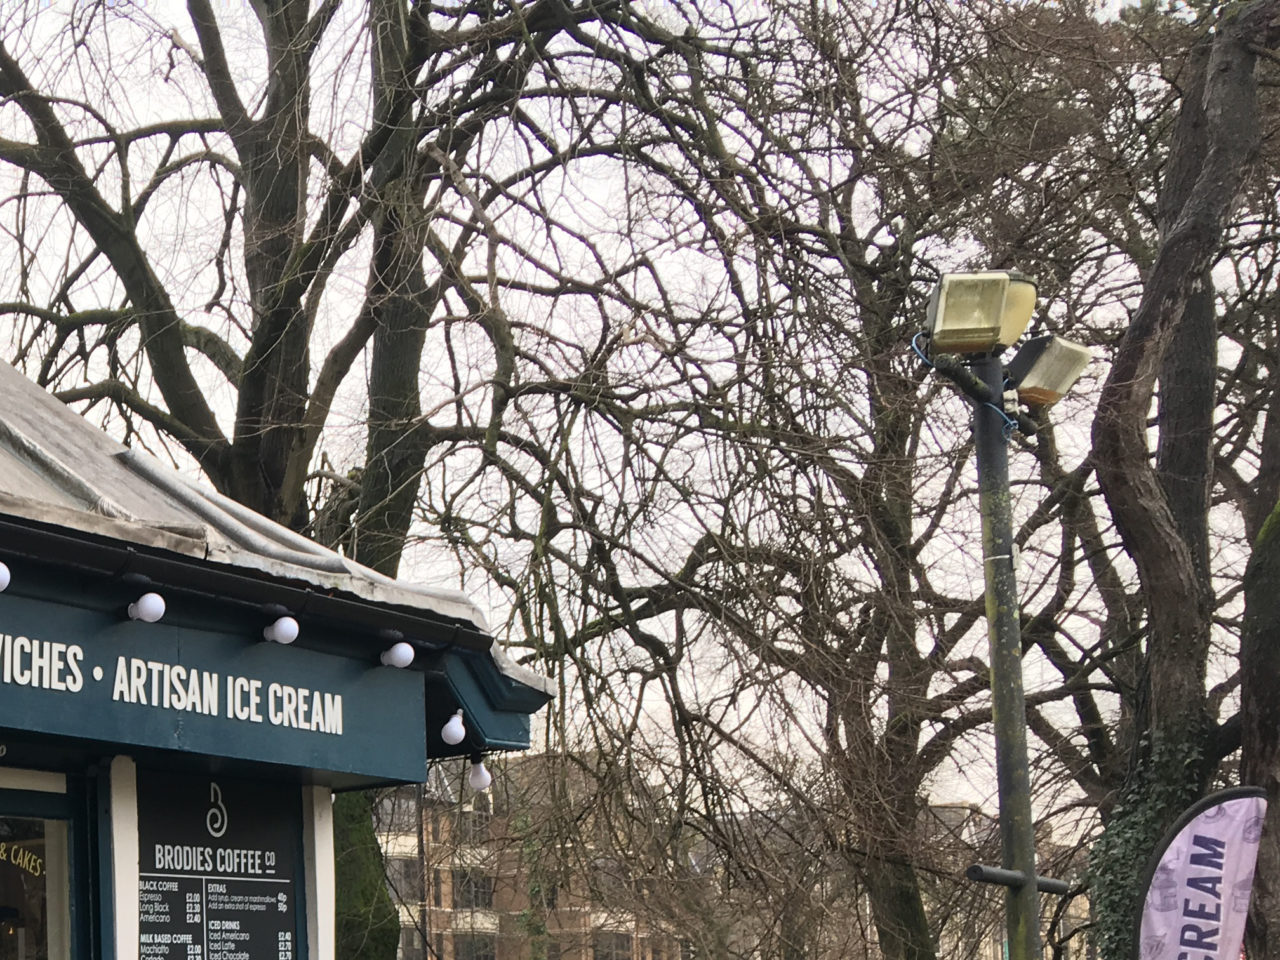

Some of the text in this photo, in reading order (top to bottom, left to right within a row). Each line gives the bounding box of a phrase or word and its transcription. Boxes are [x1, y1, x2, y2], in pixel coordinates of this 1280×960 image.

[113, 656, 343, 735] ARTISAN ICE CREAM
[0, 842, 7, 860] &
[11, 845, 42, 876] CAKES
[155, 844, 212, 872] BRODIES
[216, 848, 262, 874] COFFEE
[139, 880, 178, 891] BLACK COFFEE
[208, 884, 226, 893] EXTRAS
[140, 902, 153, 914] Long
[154, 902, 169, 912] Black
[140, 913, 170, 922] Americano
[208, 920, 240, 930] ICED DRINKS
[140, 934, 192, 944] MILK BASED COFFEE
[209, 931, 221, 940] Iced
[222, 930, 250, 940] Americano
[209, 941, 221, 950] Iced
[222, 941, 235, 950] Latte
[209, 951, 221, 960] Iced
[222, 951, 249, 960] Chocolate
